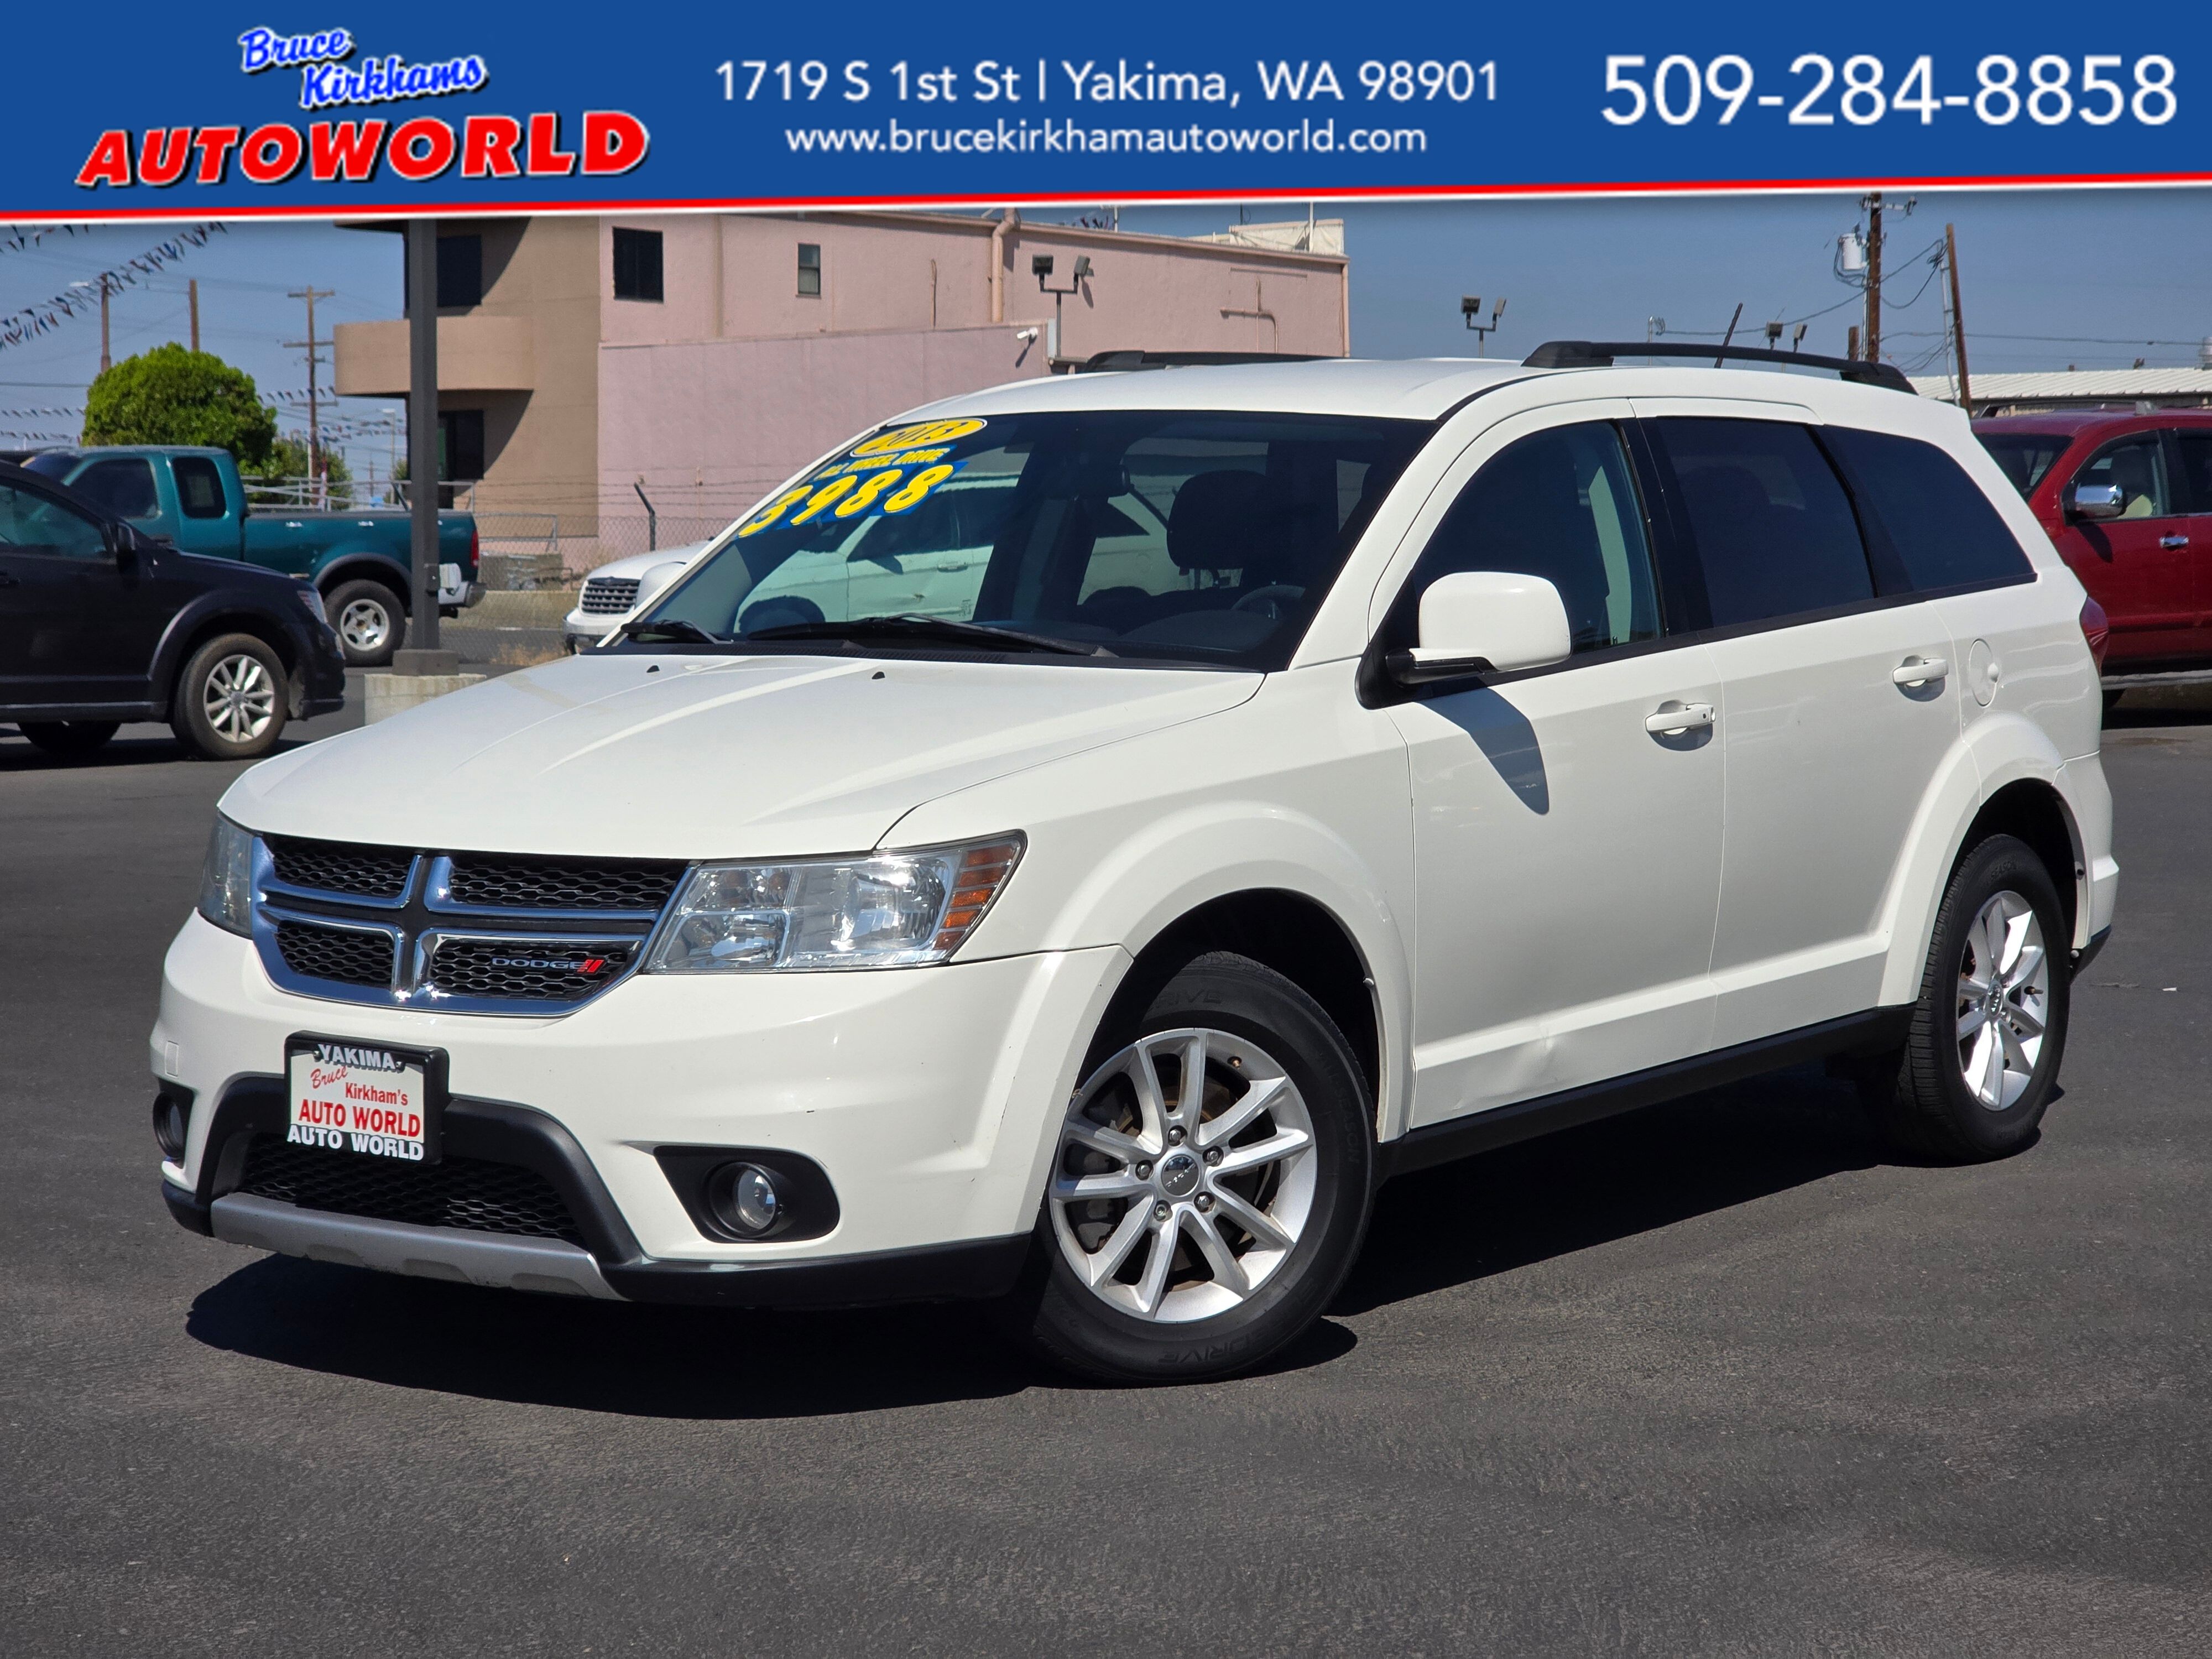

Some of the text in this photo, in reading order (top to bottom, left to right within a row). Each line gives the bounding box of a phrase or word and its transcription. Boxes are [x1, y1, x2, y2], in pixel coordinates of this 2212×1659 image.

[738, 463, 954, 538] 3988
[492, 957, 584, 970] DODGE
[318, 1044, 396, 1070] YAKIMA
[310, 1066, 348, 1089] Bruce
[345, 1082, 408, 1106] Kirkham's
[299, 1099, 421, 1138] AUTO WORLD
[286, 1124, 424, 1161] AUTO WORLD
